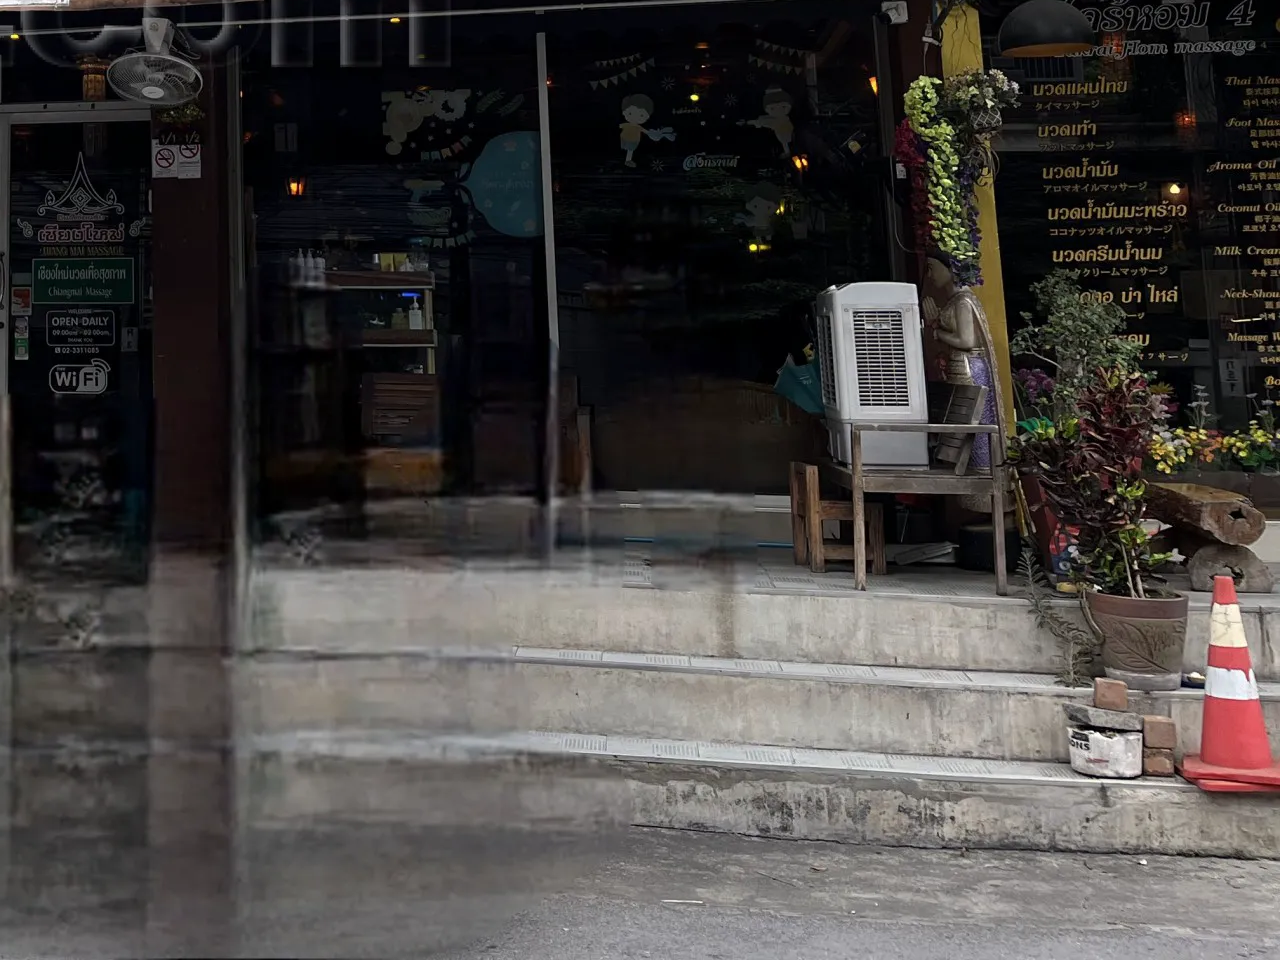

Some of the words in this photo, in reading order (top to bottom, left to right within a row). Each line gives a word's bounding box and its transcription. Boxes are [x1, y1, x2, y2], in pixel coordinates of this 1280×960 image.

[1173, 39, 1257, 57] massage
[1032, 75, 1129, 96] นวดแผนไทย
[1225, 76, 1252, 86] Thai
[1034, 99, 1100, 112] タイマッサージ
[1037, 120, 1097, 137] นวดเท้า
[1225, 117, 1252, 127] Foot
[1042, 157, 1119, 180] นวดน้ำมัน
[1206, 161, 1253, 173] Aroma
[1258, 159, 1277, 170] Oil
[1043, 181, 1149, 194] アロマオイルマッサージ
[1047, 199, 1188, 221] นวดน้ำมันมะพร้าว
[1216, 203, 1261, 213] Coconut
[37, 222, 125, 243] เชียงใหม่
[1049, 224, 1173, 237] ココナッツオイルマッサージ
[86, 245, 125, 256] MASSAGE
[1051, 240, 1163, 263] นวดครีมน้ำนม
[1213, 245, 1243, 256] Milk
[37, 261, 127, 284] เชียงใหม่นวดเพื่อสุขภาพ
[48, 286, 83, 299] Chiangmai
[85, 286, 113, 299] Massage
[1121, 287, 1142, 304] บ่า
[1147, 283, 1178, 303] ไหล่
[51, 316, 78, 327] OPEN
[81, 316, 109, 327] DAILY
[1227, 332, 1269, 344] Massage
[54, 370, 100, 387] WiFi
